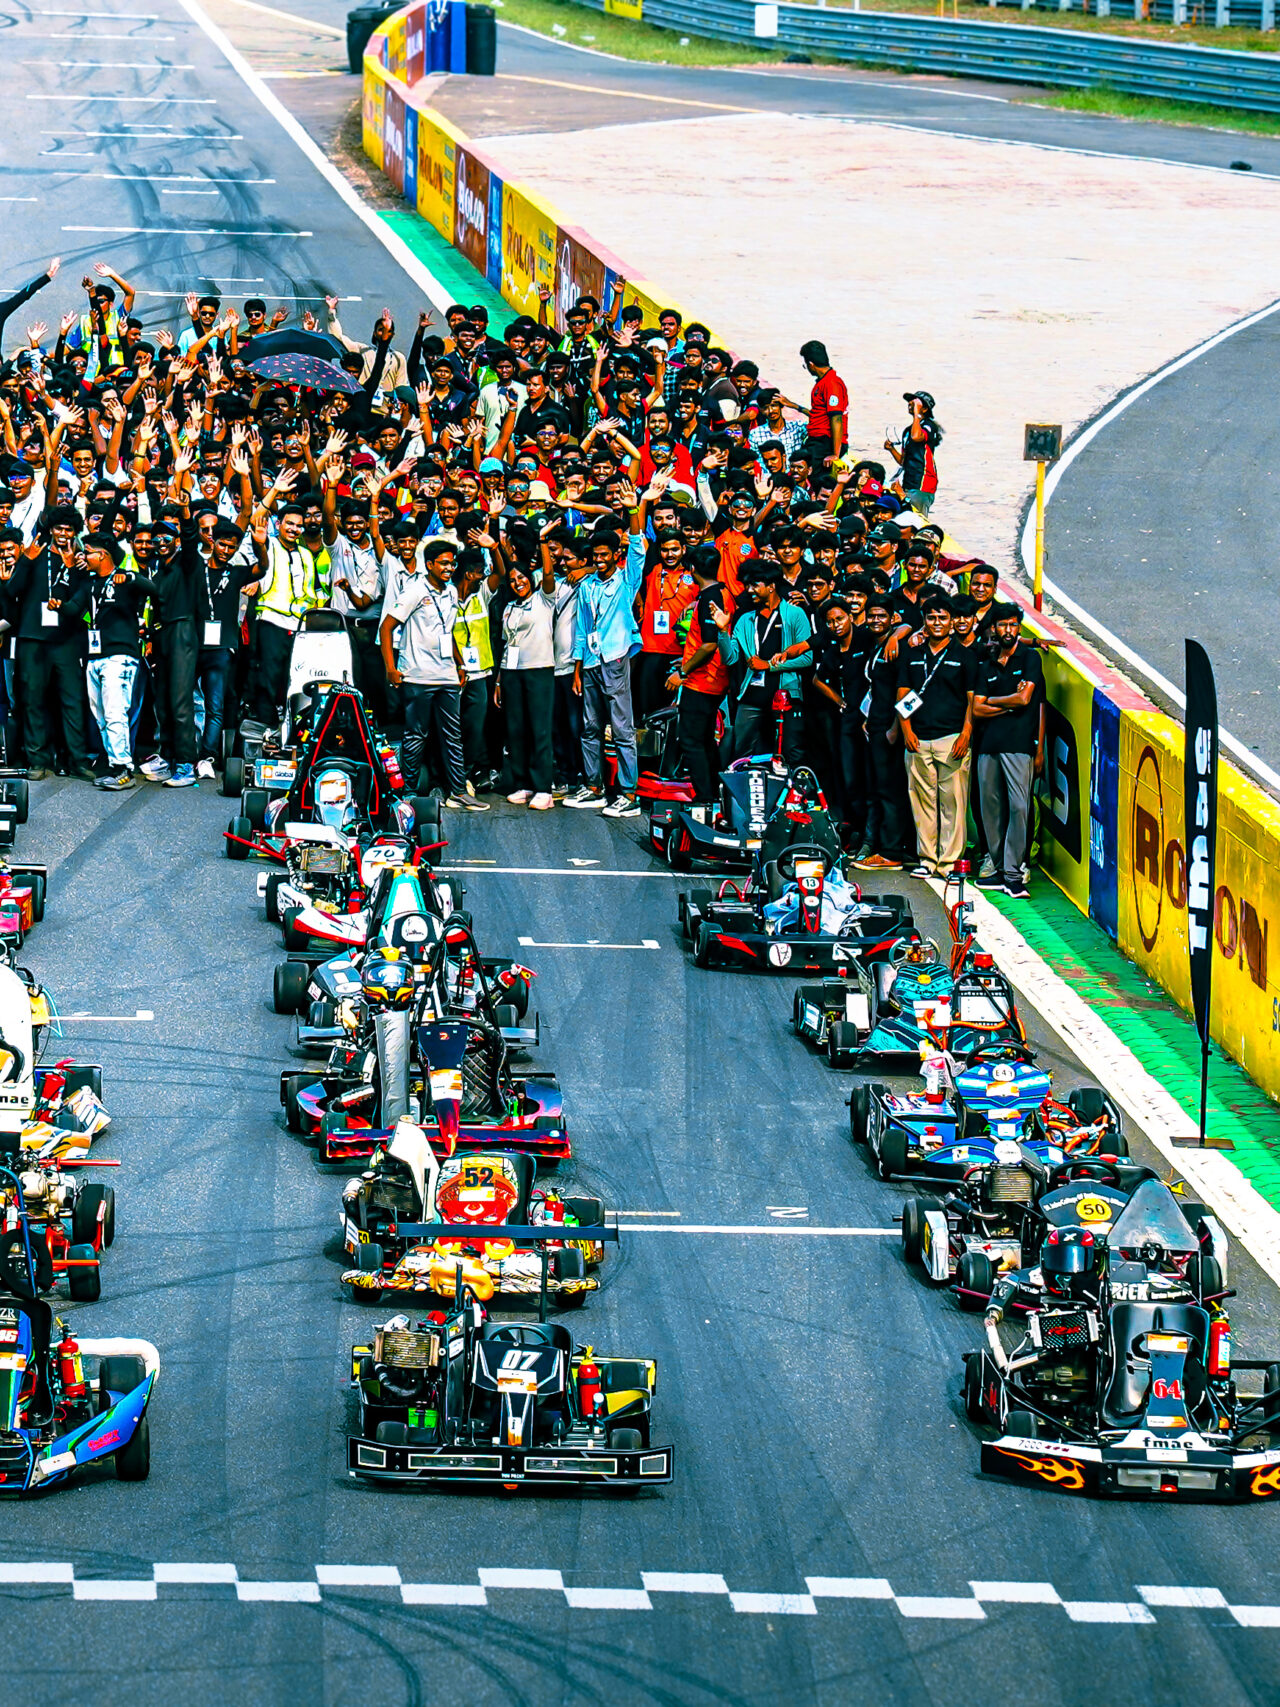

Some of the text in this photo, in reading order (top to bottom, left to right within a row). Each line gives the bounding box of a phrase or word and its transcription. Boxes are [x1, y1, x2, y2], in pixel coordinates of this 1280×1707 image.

[373, 849, 395, 858] 70
[804, 878, 817, 888] 13
[464, 1167, 494, 1188] 52
[1083, 1203, 1105, 1215] 50
[0, 1307, 16, 1319] ZR
[500, 1349, 543, 1370] 07
[1153, 1377, 1183, 1400] 64
[1143, 1437, 1193, 1449] fmae
